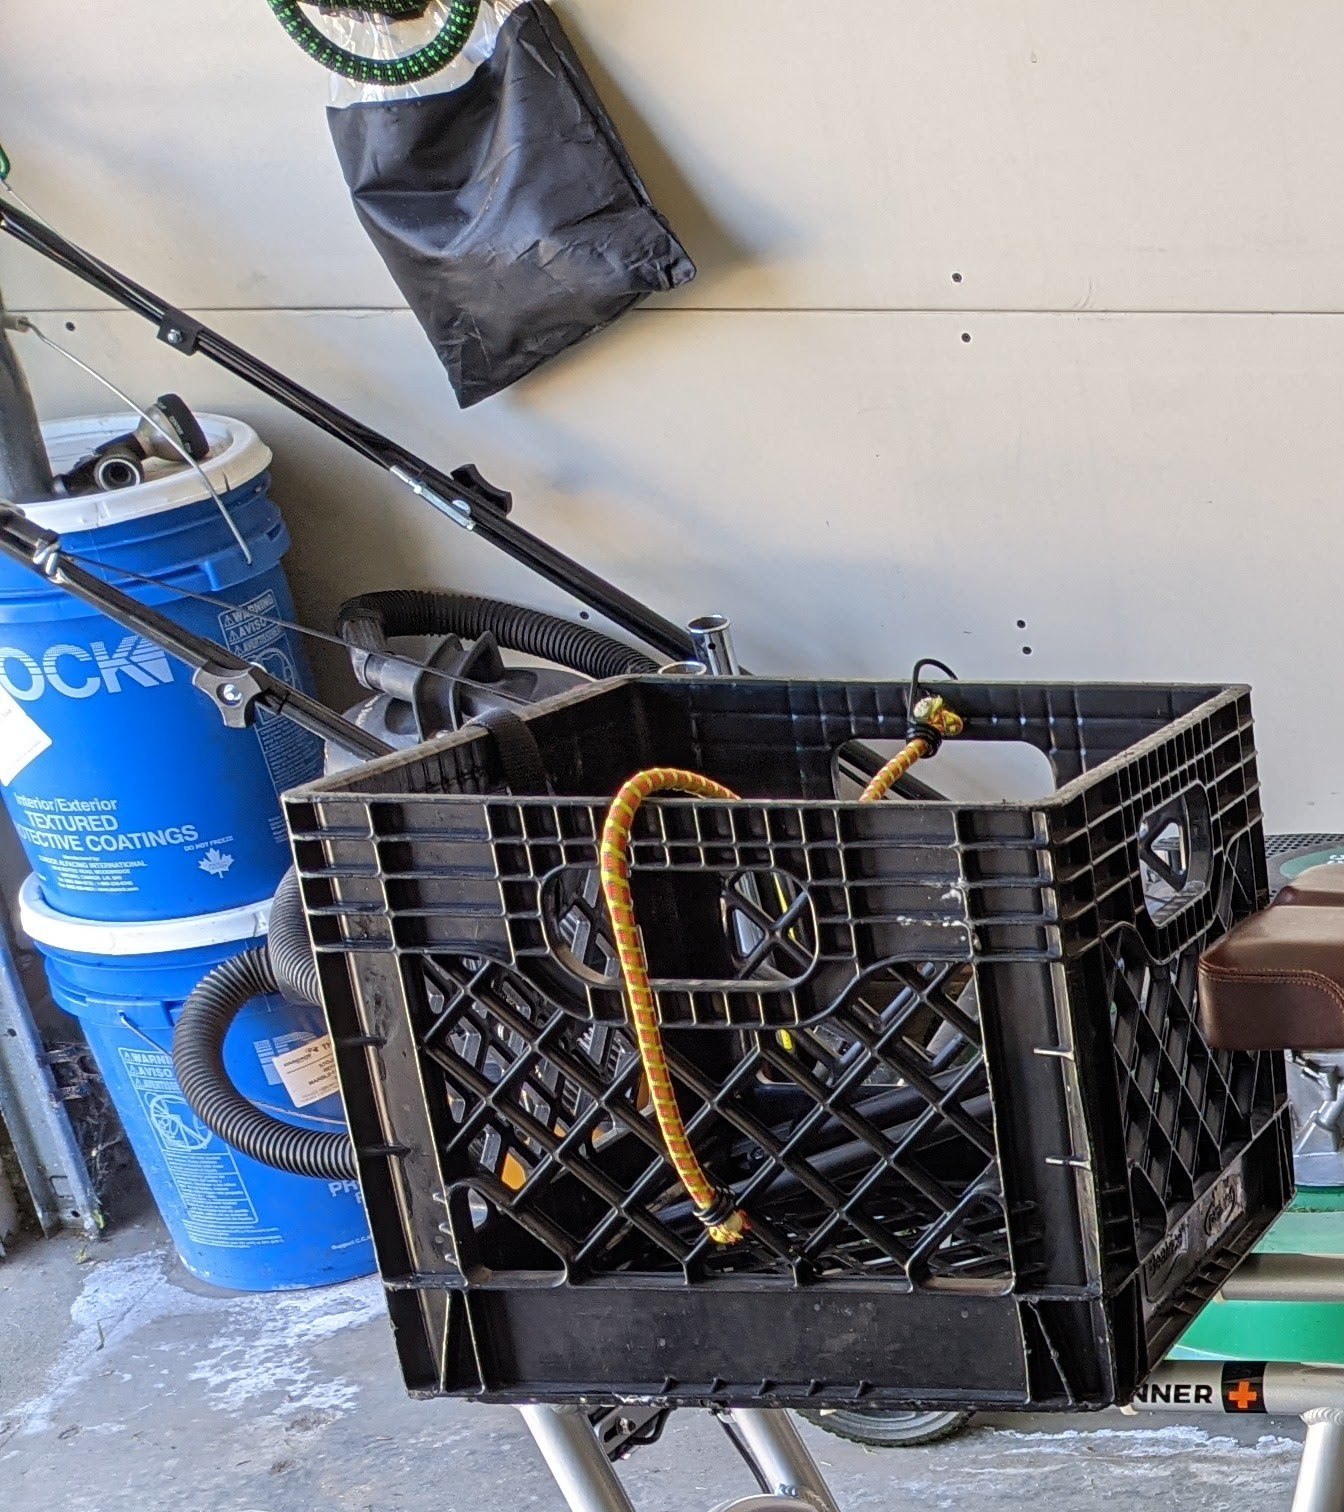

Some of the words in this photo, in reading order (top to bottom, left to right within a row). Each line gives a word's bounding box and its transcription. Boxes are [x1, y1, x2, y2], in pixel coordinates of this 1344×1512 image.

[13, 792, 118, 813] Interior/Exterior
[24, 810, 119, 832] TEXTURED
[86, 824, 199, 852] COATINGS
[132, 1053, 172, 1065] WARNI
[137, 1065, 172, 1077] AVISO
[1133, 1384, 1214, 1405] NNER
